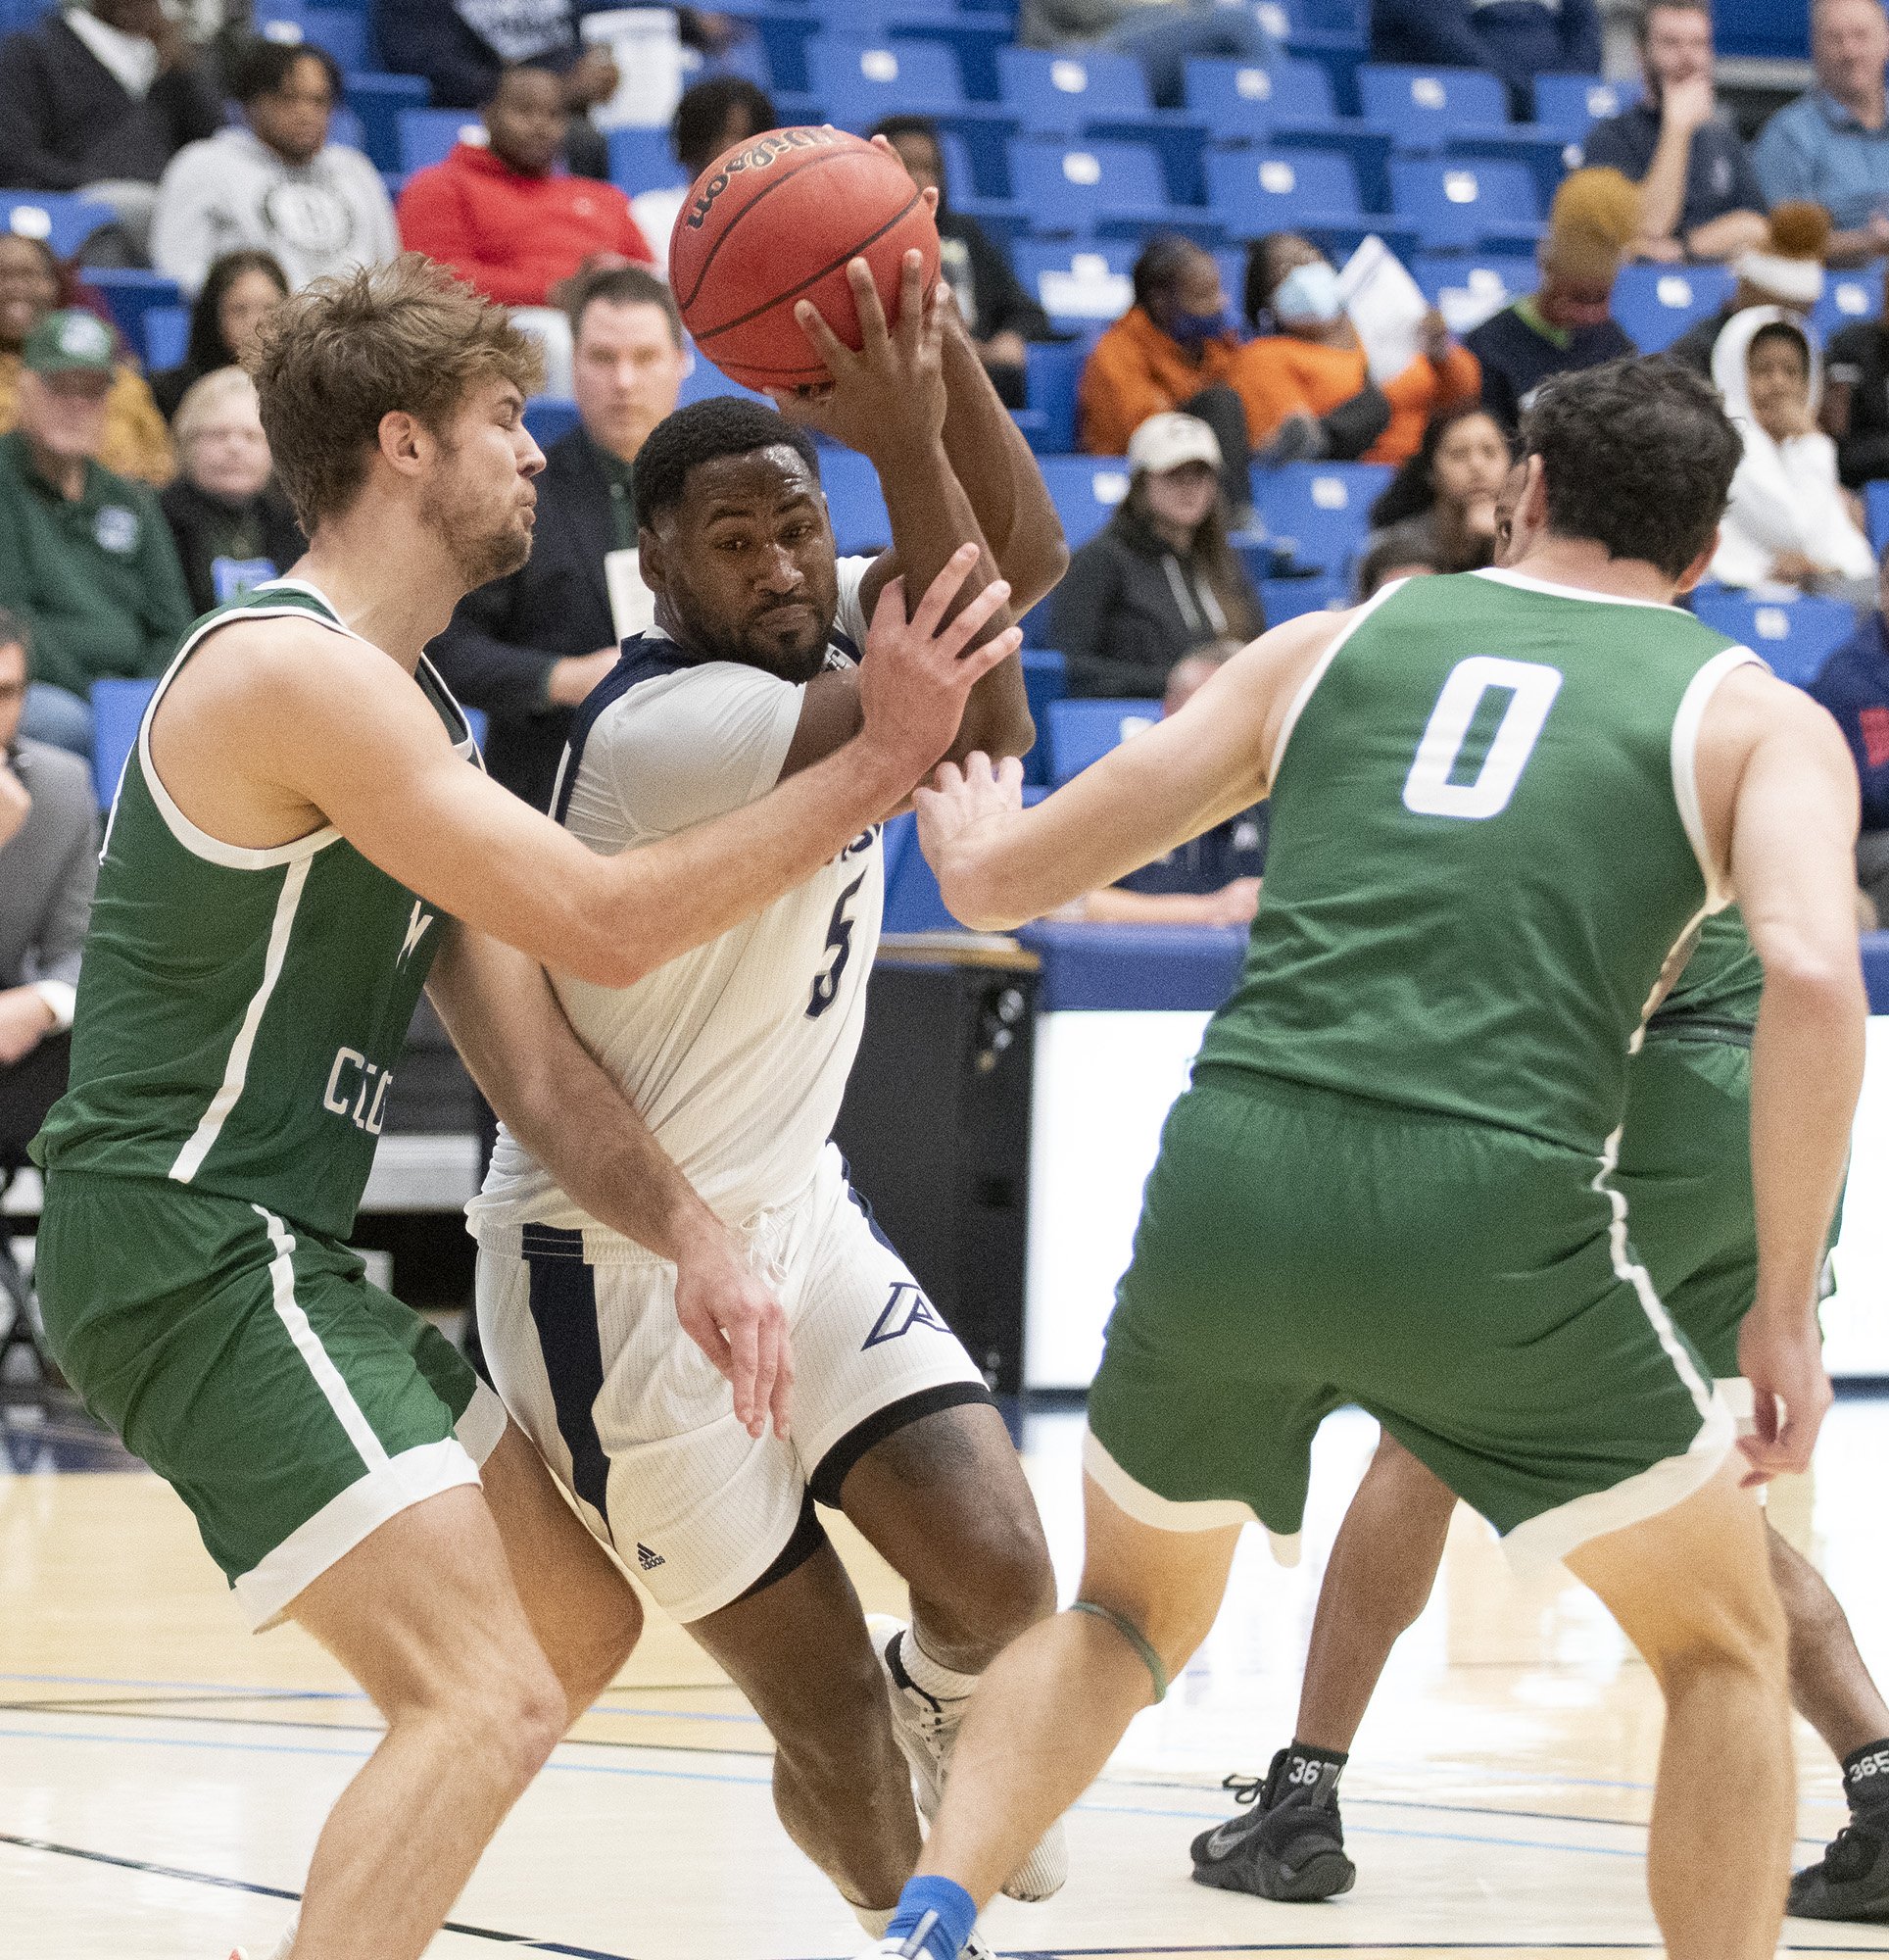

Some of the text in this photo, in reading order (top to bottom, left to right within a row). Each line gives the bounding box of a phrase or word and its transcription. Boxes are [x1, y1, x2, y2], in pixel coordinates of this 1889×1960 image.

[1401, 654, 1564, 821] 0
[803, 863, 869, 1022] 5
[640, 1555, 666, 1571] adidas
